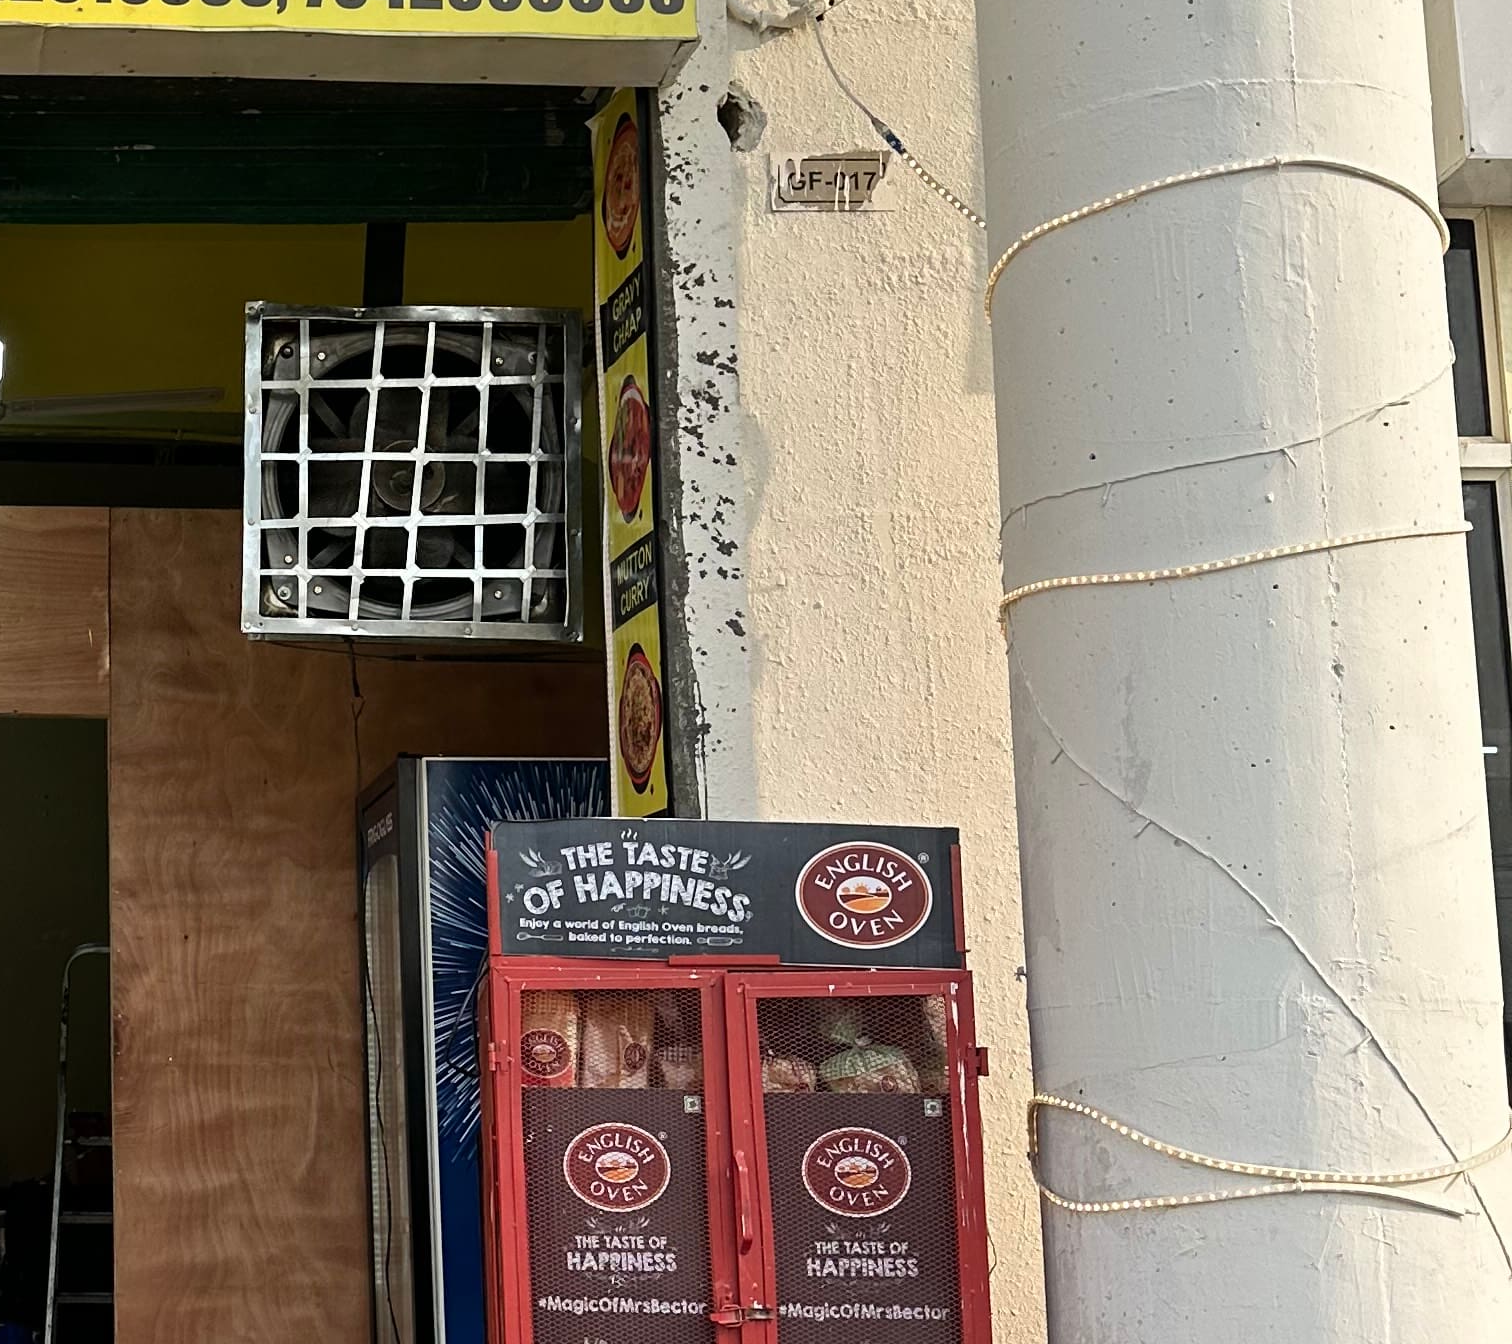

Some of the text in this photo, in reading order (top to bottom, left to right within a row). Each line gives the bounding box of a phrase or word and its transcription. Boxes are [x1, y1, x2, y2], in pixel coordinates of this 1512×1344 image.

[611, 271, 643, 323] GRAVY
[612, 307, 644, 354] CHAAP
[616, 539, 653, 587] MUTTON
[619, 574, 651, 616] CURRY
[560, 839, 710, 875] THE TASTE
[814, 853, 913, 892] ENGLISH
[522, 869, 751, 923] OF HAPPINESS
[519, 917, 550, 930] Enjoy
[552, 920, 562, 929] a
[564, 919, 599, 930] world
[602, 920, 616, 930] of
[618, 920, 659, 933] English
[661, 921, 694, 933] Oven
[828, 909, 905, 937] OVEN
[568, 931, 693, 946] baked to perfection.
[578, 1133, 655, 1164] ENGLISH
[816, 1137, 896, 1169] ENGLISH
[590, 1178, 649, 1202] OVEN
[829, 1183, 889, 1207] OVEN
[574, 1235, 668, 1250] THE TASTE OF
[814, 1240, 909, 1256] THE TASTE OF
[566, 1251, 678, 1272] HAPPINESS
[806, 1257, 920, 1278] HAPPINESS
[538, 1295, 708, 1316] #MagicOfMrsBector
[779, 1302, 951, 1322] #MagicOfMrsBector
